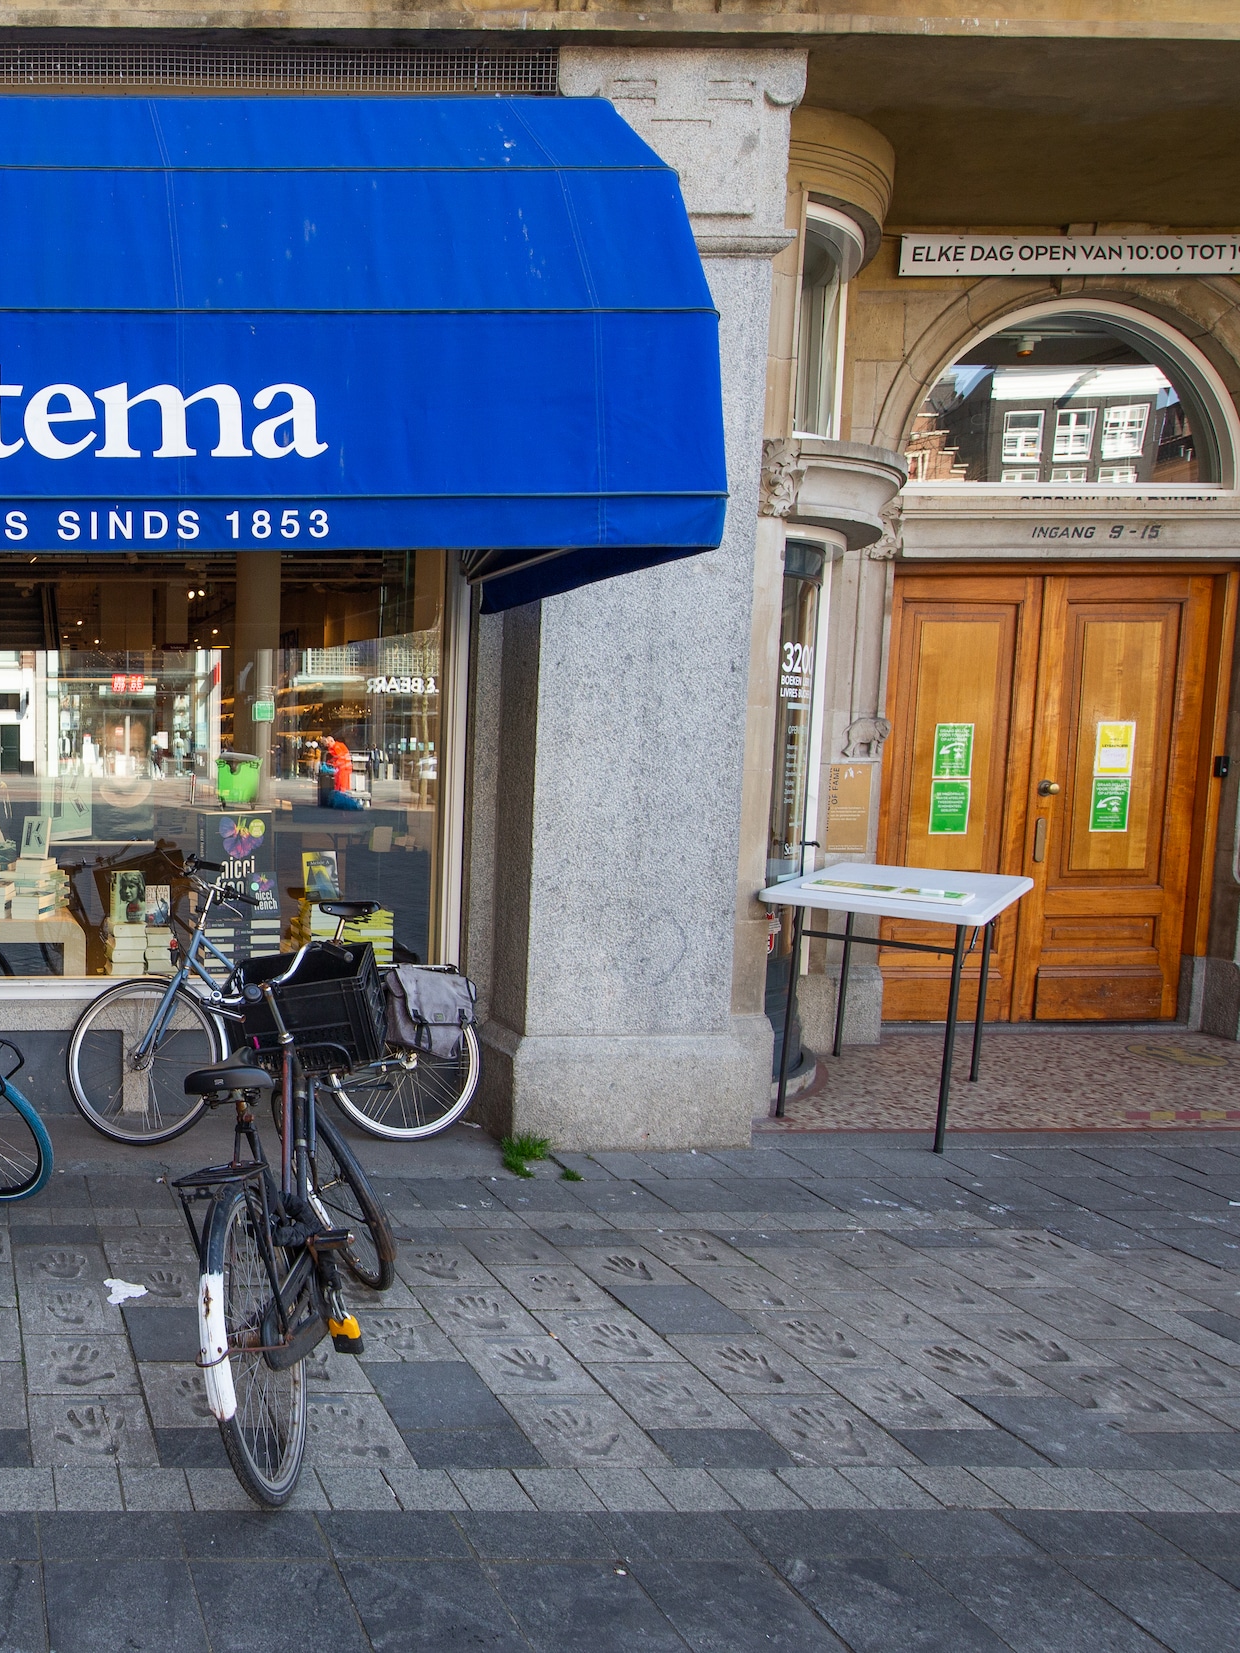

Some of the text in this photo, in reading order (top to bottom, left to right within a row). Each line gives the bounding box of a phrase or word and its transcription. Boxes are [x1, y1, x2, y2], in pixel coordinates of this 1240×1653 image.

[912, 246, 965, 262] ELKE
[970, 245, 1014, 262] DAG
[1018, 245, 1077, 262] OPEN
[1080, 245, 1122, 260] VAN
[1128, 244, 1183, 260] 10:00
[1187, 244, 1227, 260] TOT
[57, 506, 201, 541] SINDS
[226, 508, 330, 539] 1853
[1032, 526, 1096, 538] INGANG
[780, 687, 797, 698] LIVRES
[831, 768, 840, 804] OF FAME
[221, 856, 255, 879] nicci
[256, 890, 273, 900] nicci
